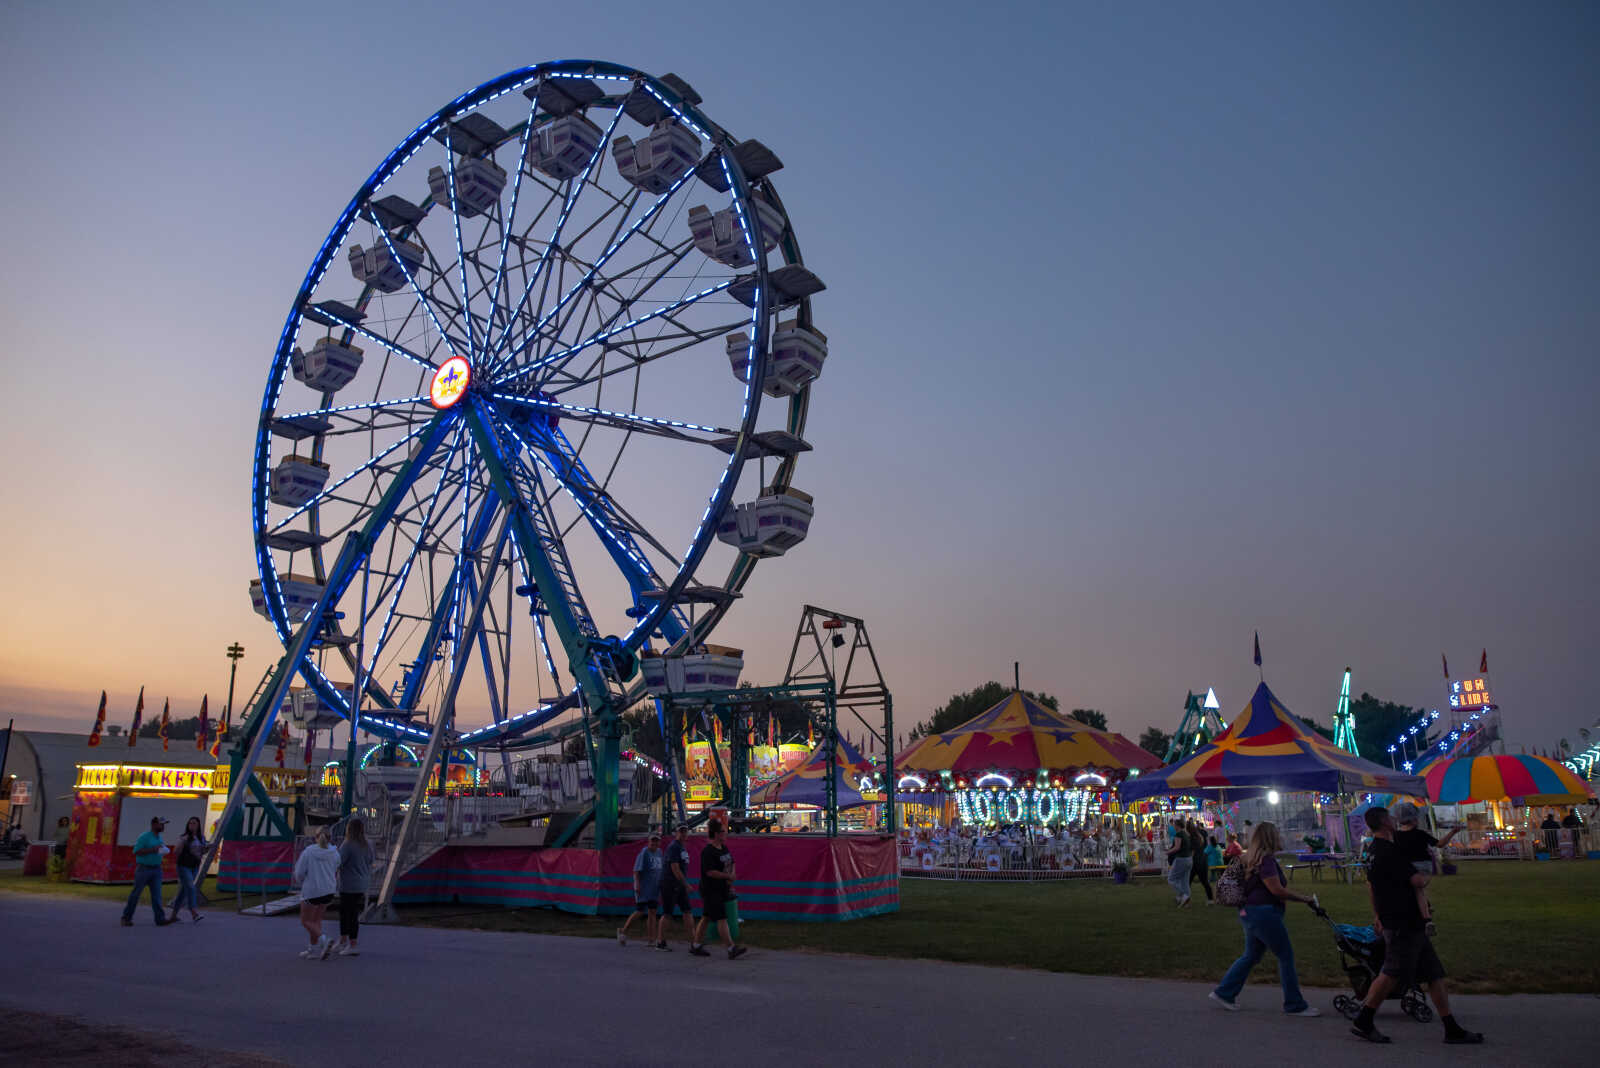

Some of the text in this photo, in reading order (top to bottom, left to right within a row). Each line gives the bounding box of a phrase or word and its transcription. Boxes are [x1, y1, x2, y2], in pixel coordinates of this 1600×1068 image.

[1451, 679, 1484, 693] FUN
[1449, 691, 1489, 706] SLIDE
[127, 768, 209, 788] TICKETS
